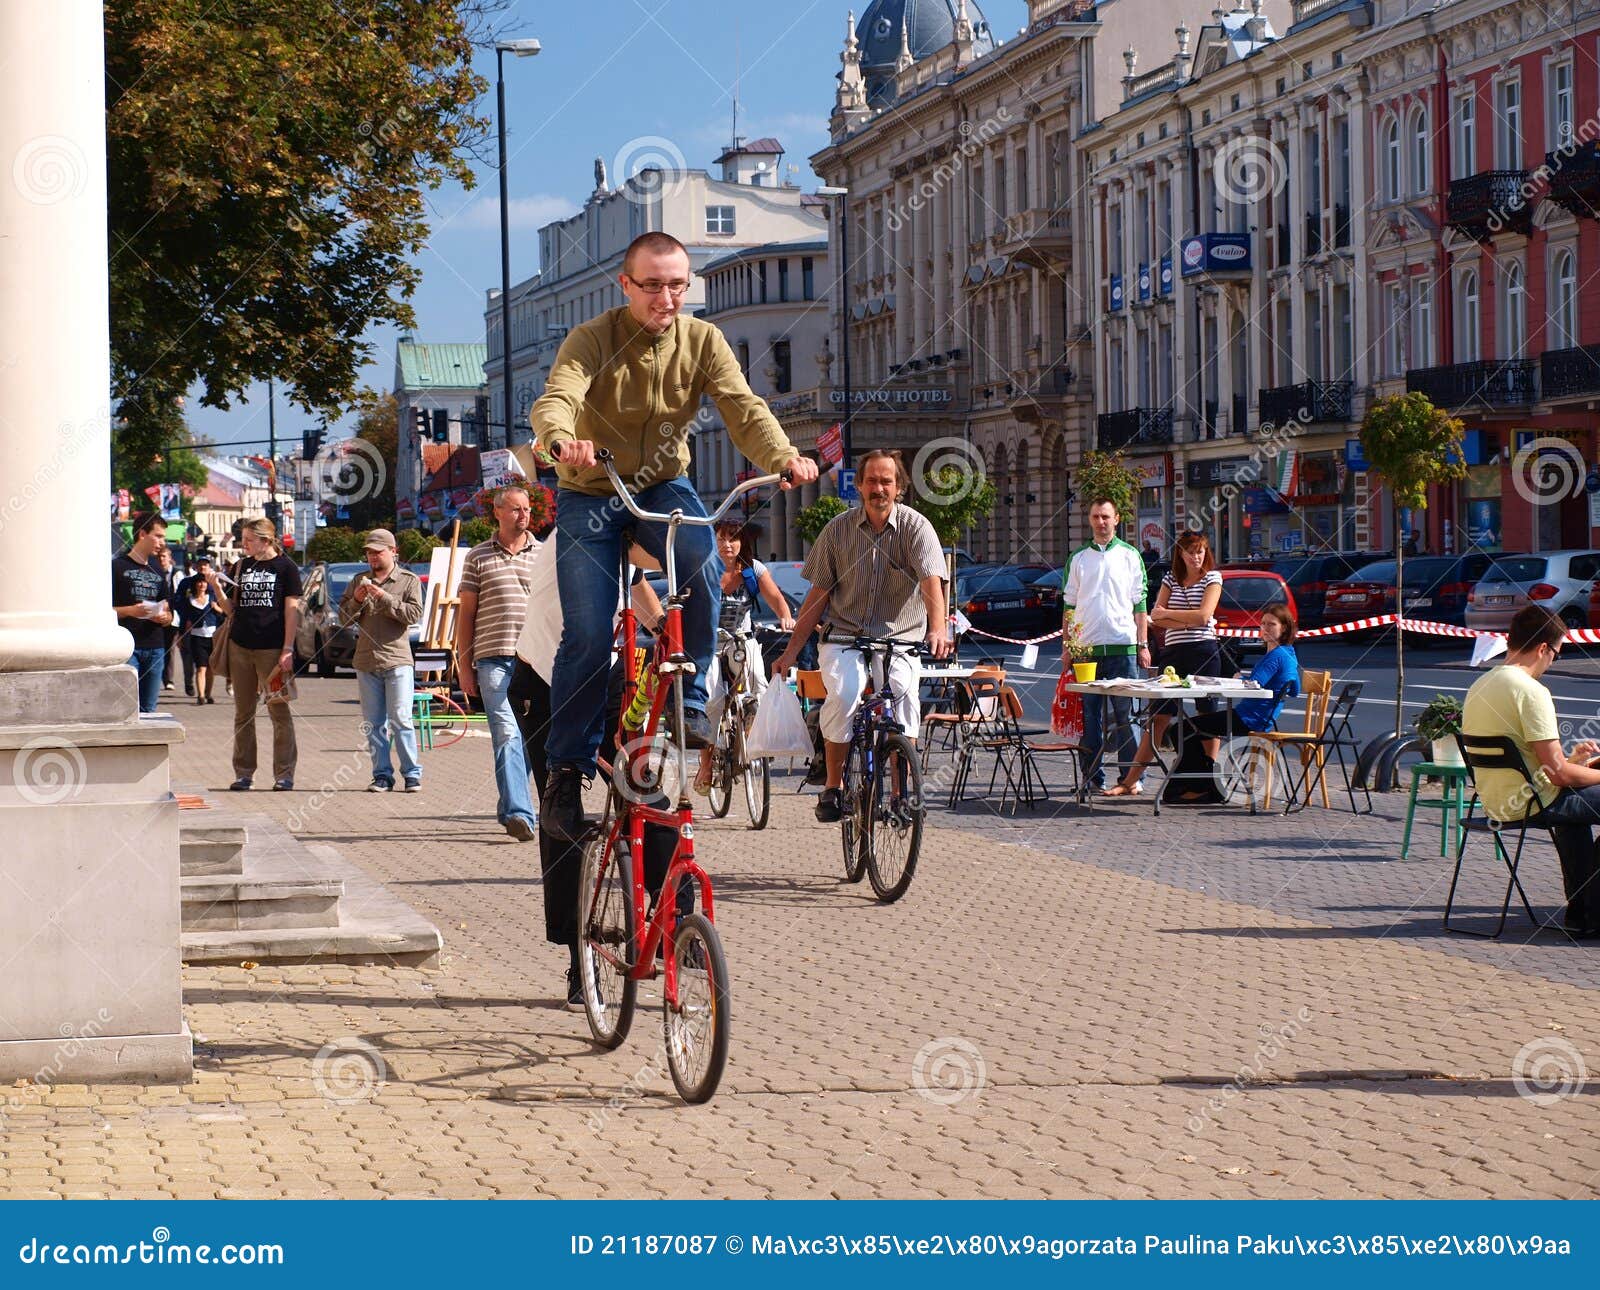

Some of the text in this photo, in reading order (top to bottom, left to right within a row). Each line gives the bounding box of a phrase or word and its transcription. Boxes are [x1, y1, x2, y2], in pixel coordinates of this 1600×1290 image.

[896, 390, 952, 401] HOTEL
[242, 583, 275, 591] FORUM
[240, 599, 273, 607] LUBLINA
